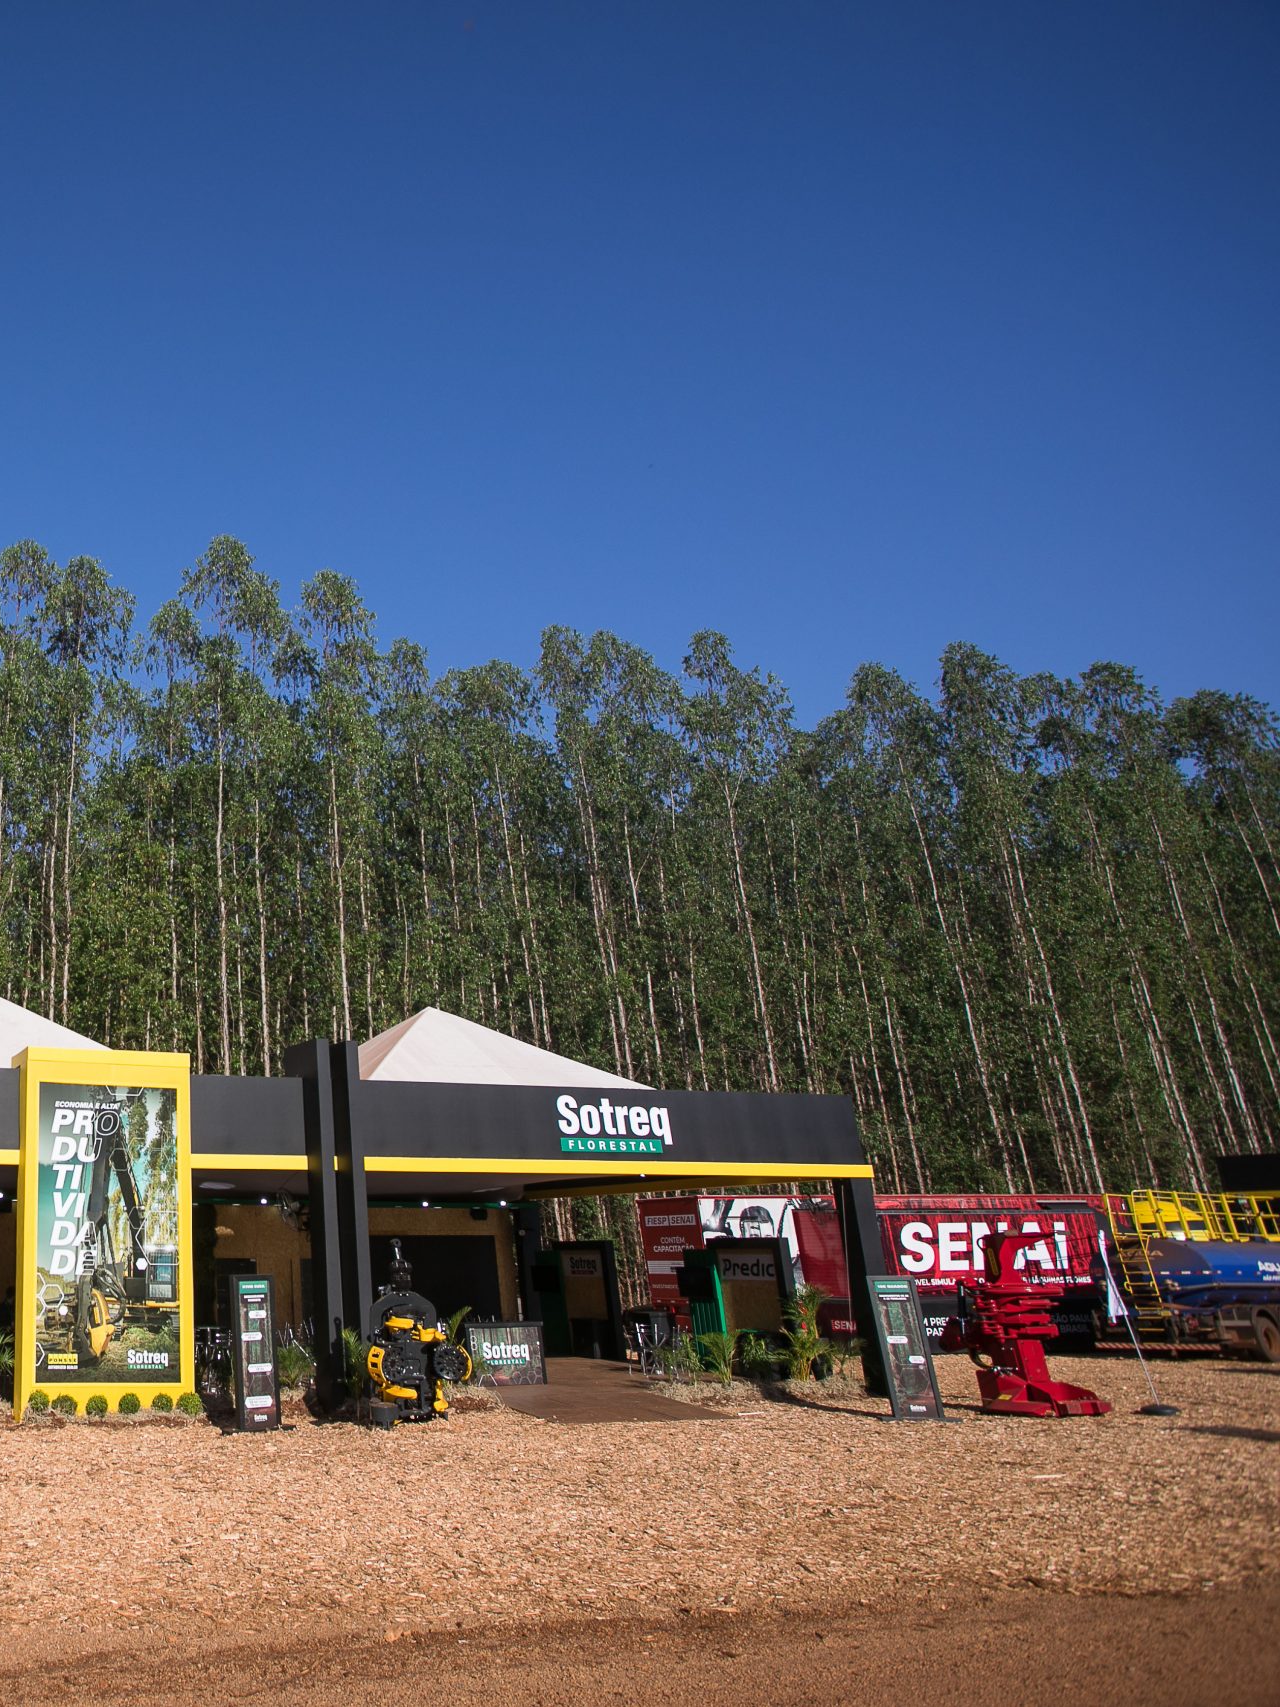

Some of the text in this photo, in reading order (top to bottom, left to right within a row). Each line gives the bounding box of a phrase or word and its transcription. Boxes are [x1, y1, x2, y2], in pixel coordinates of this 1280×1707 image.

[54, 1101, 93, 1109] ECONOMIA
[101, 1102, 121, 1110] ALTA
[51, 1108, 120, 1136] PRO
[556, 1094, 673, 1145] Sotreq
[51, 1136, 103, 1163] DU
[568, 1140, 657, 1152] FLORESTAL
[52, 1163, 83, 1190] TI
[53, 1191, 86, 1218] VI
[50, 1220, 97, 1247] DA
[647, 1215, 694, 1225] FIESP SENAI
[49, 1248, 97, 1275] DE
[127, 1349, 169, 1367] Sotreq
[482, 1341, 530, 1361] Sotreq
